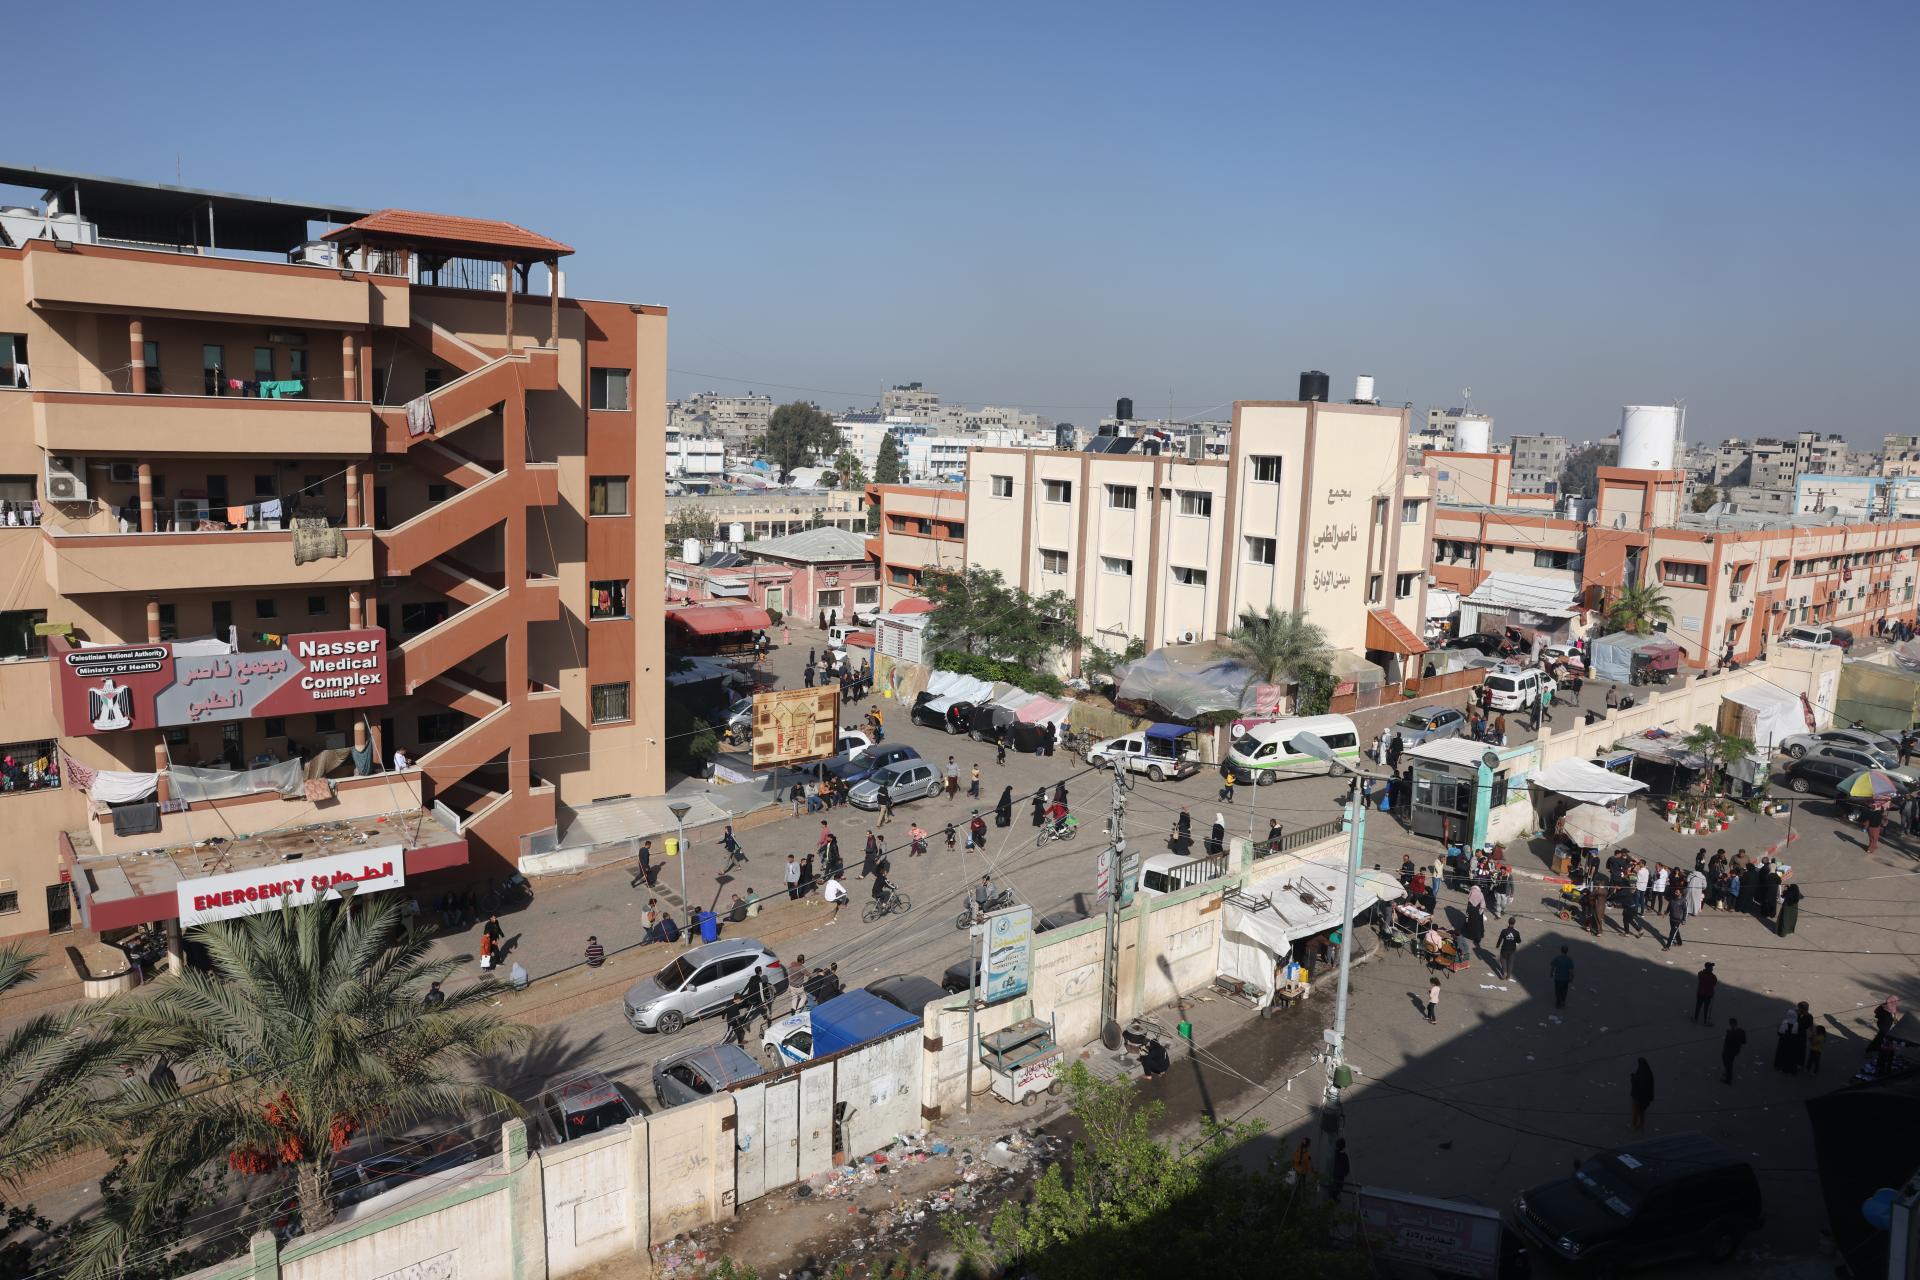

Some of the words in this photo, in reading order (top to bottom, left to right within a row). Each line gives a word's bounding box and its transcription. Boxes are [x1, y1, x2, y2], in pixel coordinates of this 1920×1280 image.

[71, 654, 106, 663] Palestinian
[107, 651, 134, 660] National
[134, 649, 162, 659] Authority
[299, 638, 380, 657] Nasser
[79, 665, 115, 675] Ministry
[117, 664, 127, 672] Of
[128, 662, 157, 671] Health
[183, 657, 232, 687] ناصر
[236, 658, 288, 685] مجمع
[310, 655, 377, 673] Medical
[301, 672, 381, 690] Complex
[312, 688, 356, 700] Building
[358, 687, 366, 695] C
[186, 688, 244, 721] الطبي
[193, 878, 306, 911] EMERGENCY
